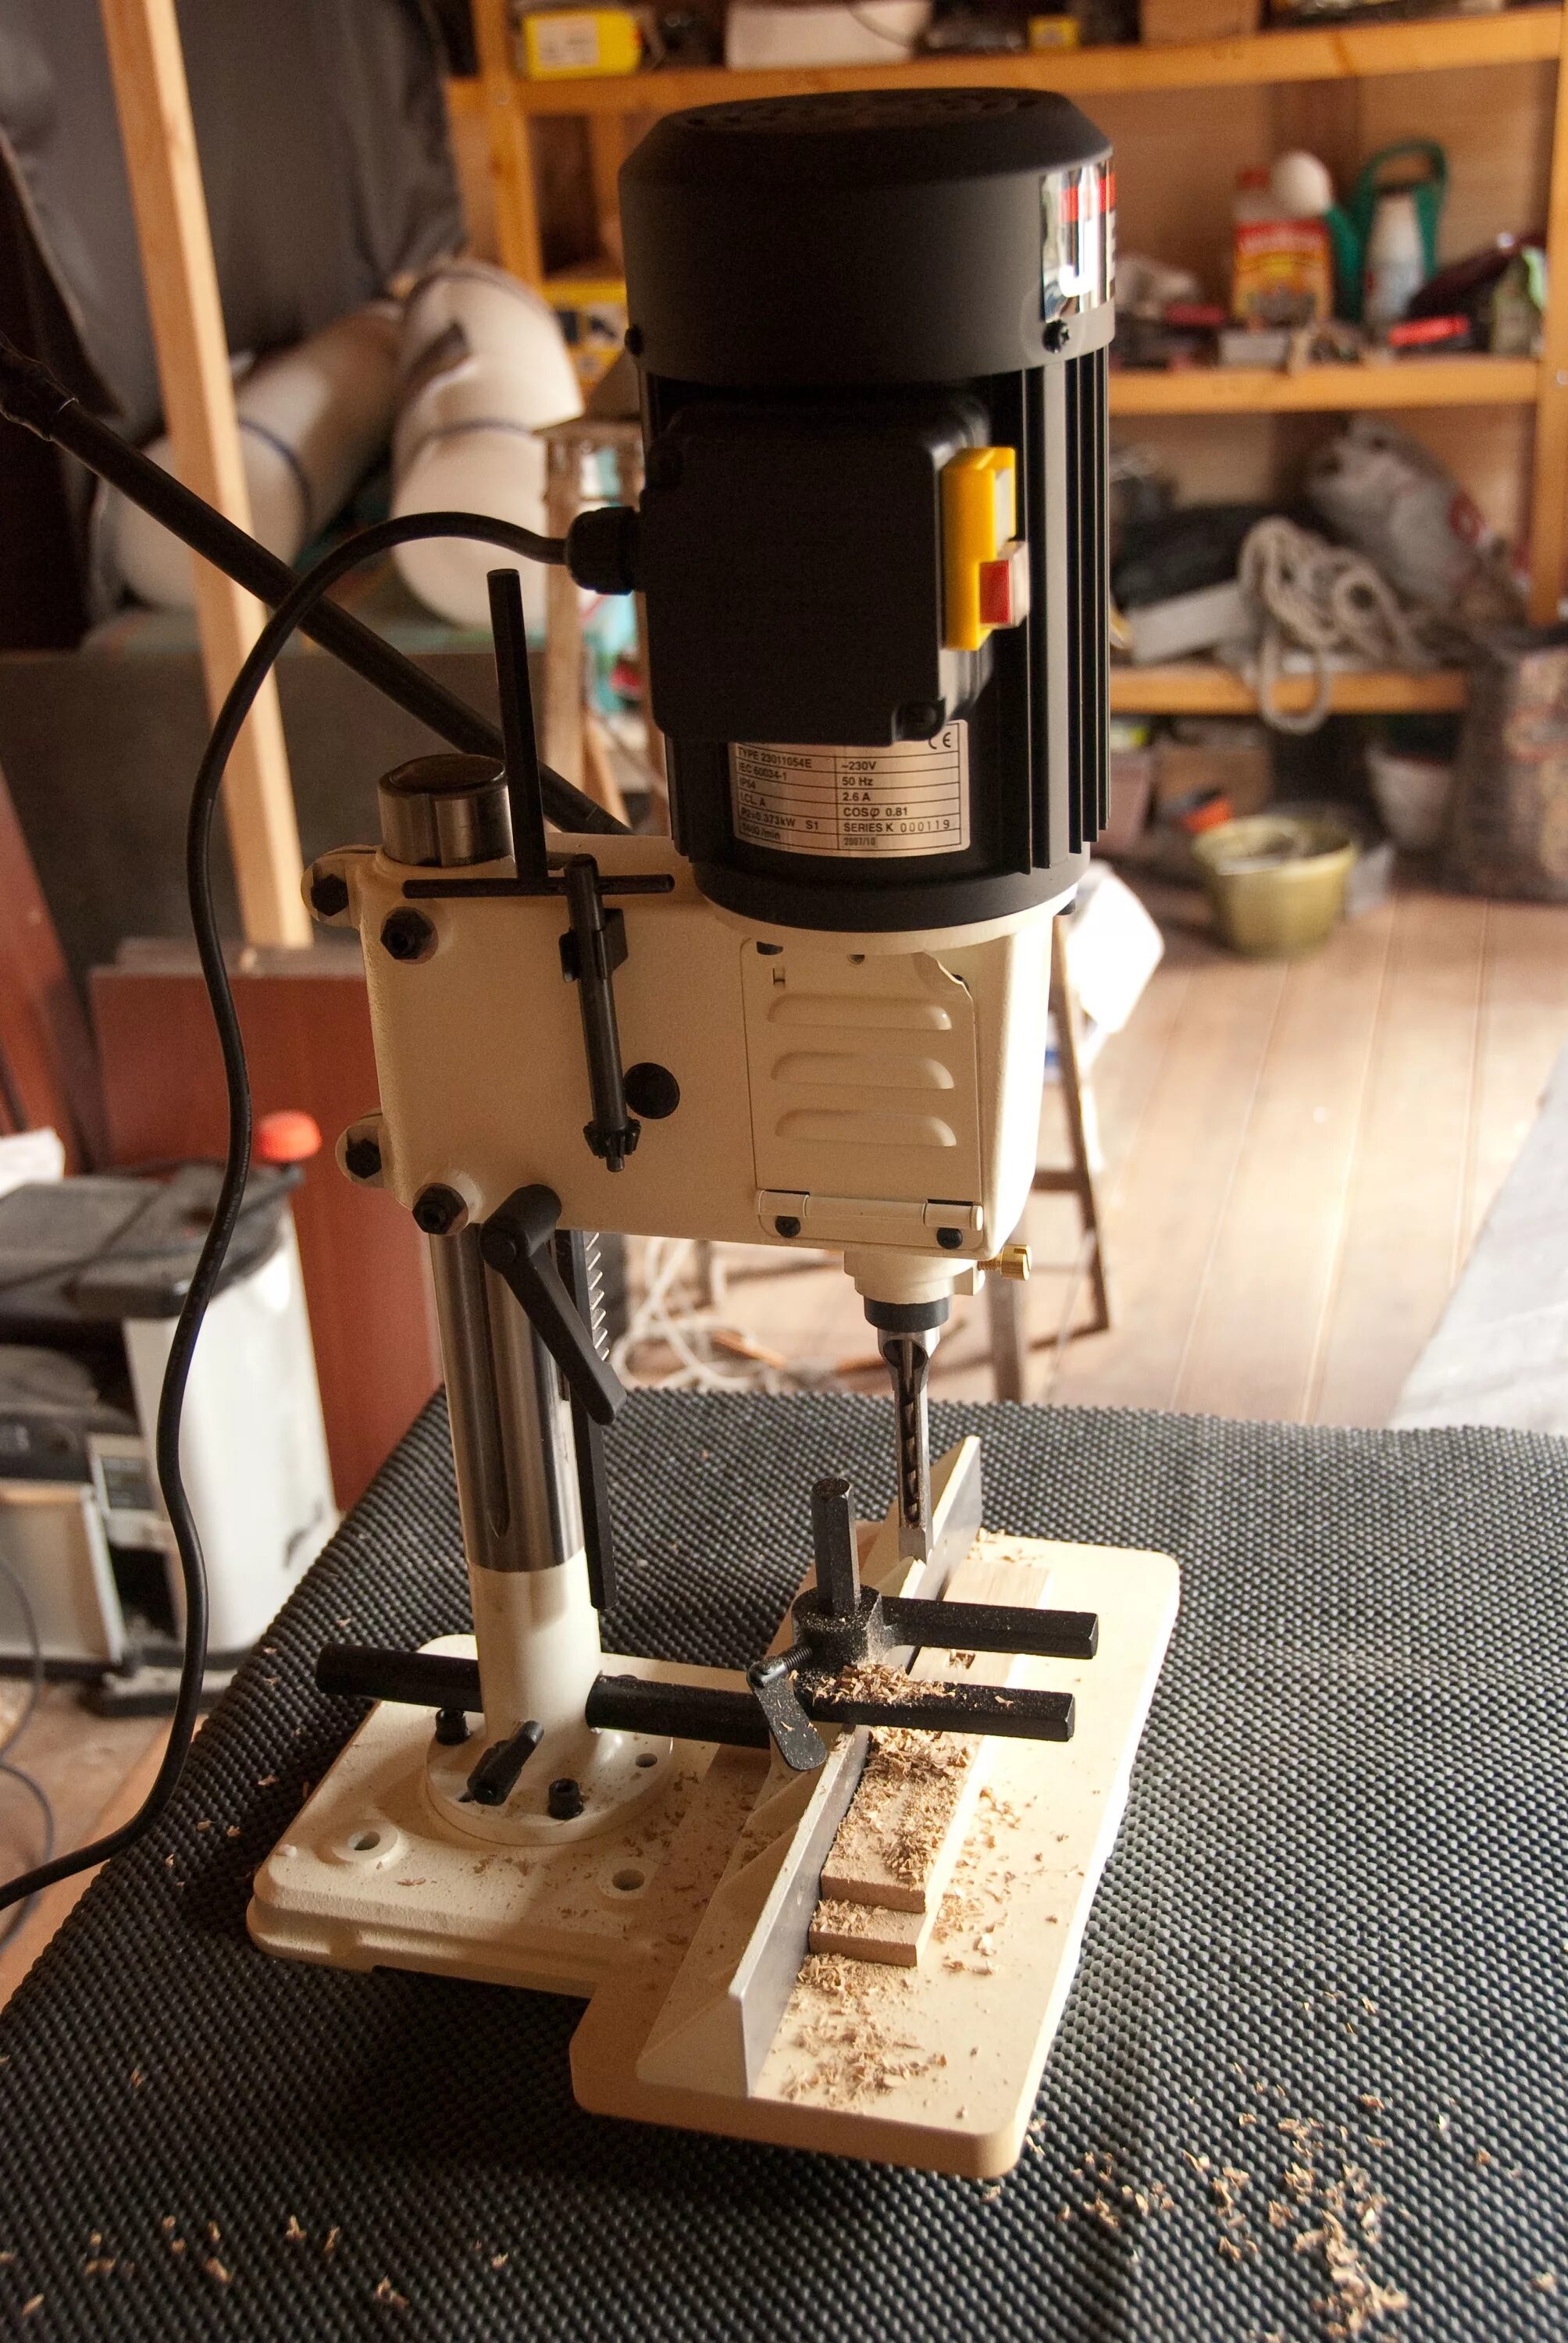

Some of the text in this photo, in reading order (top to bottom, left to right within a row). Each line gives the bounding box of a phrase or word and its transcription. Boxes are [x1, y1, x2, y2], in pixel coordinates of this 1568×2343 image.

[737, 746, 759, 761] TYPE
[842, 776, 874, 786] 50 Hz
[843, 792, 871, 801] 2.6 A
[886, 807, 908, 817] 0.81
[805, 820, 819, 830] S1
[843, 822, 883, 833] SERIES
[886, 822, 894, 833] K
